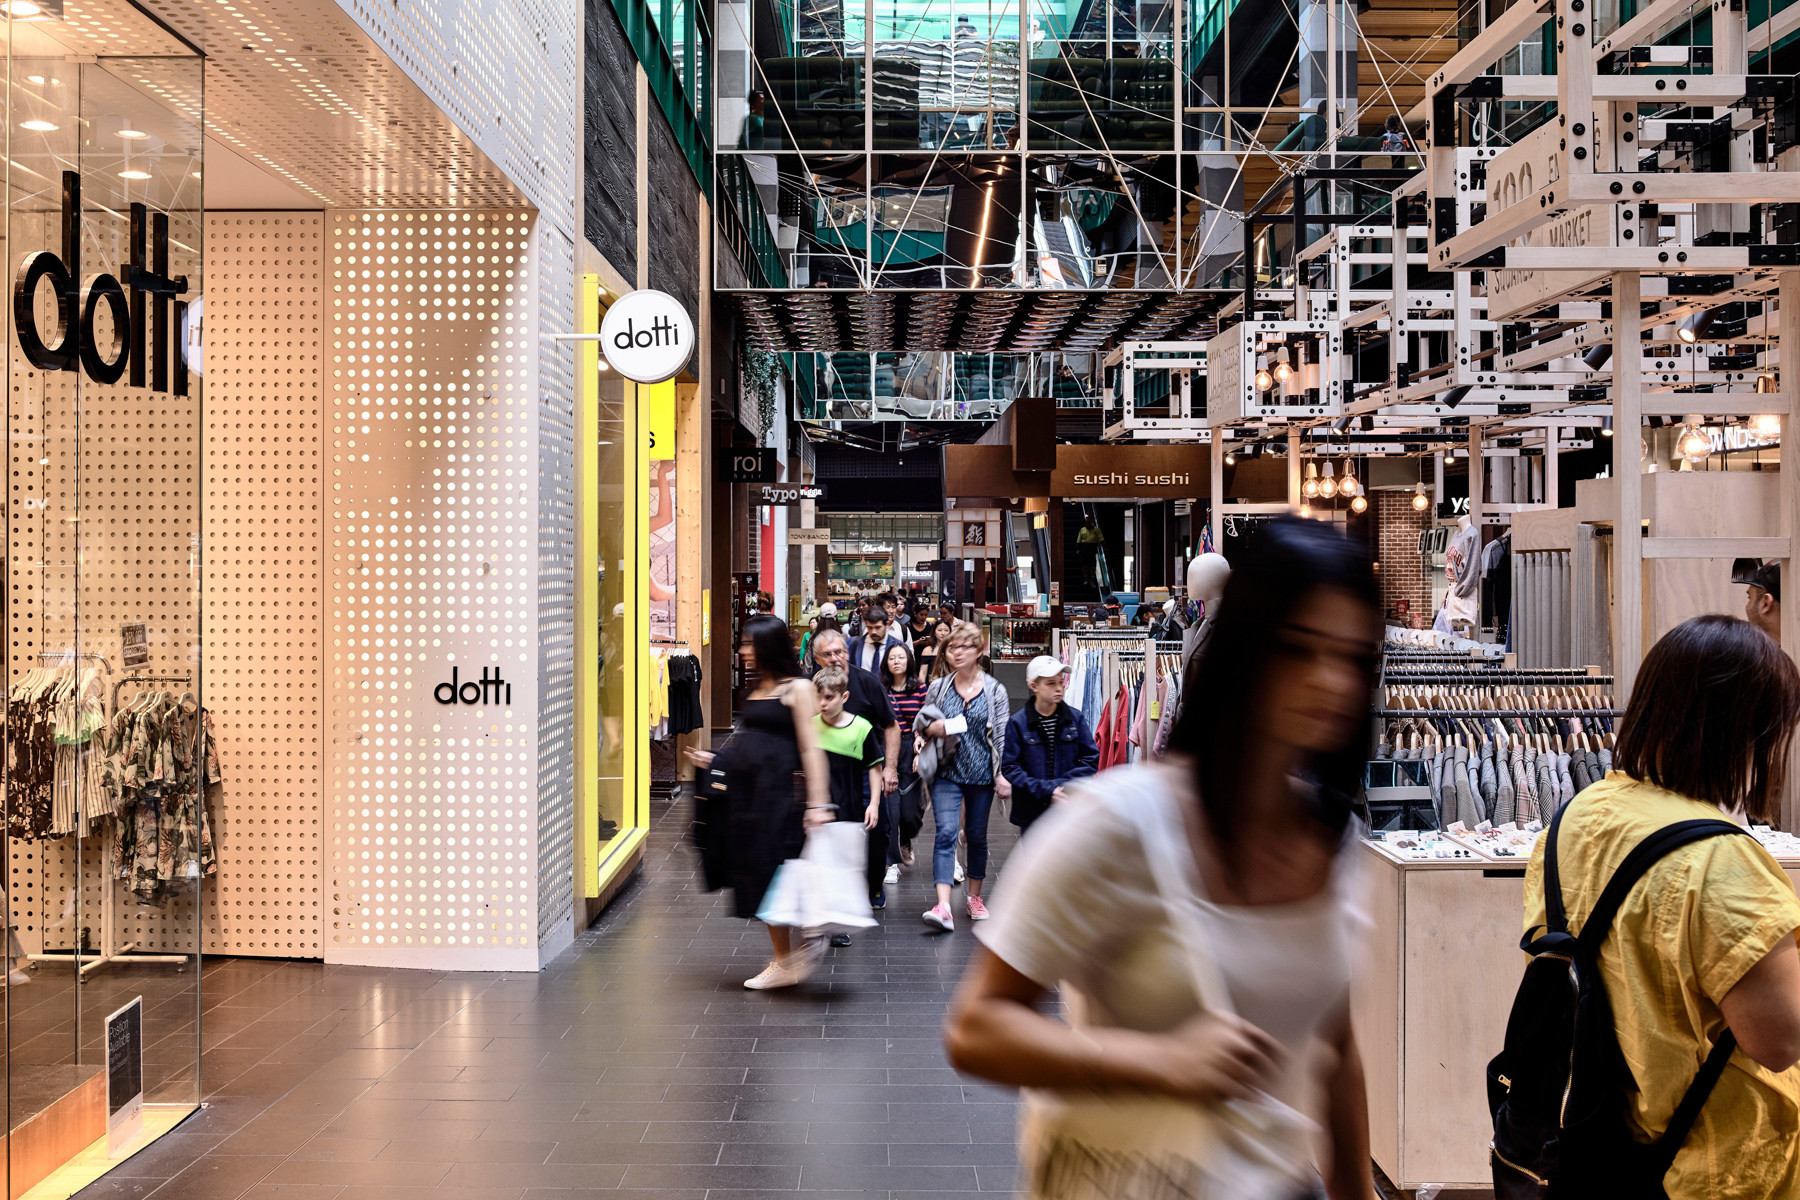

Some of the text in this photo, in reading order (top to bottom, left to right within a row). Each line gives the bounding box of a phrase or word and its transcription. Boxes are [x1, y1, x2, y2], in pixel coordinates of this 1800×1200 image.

[13, 170, 189, 397] dotti
[614, 316, 679, 349] dotti
[733, 451, 762, 472] roi
[1074, 472, 1189, 485] sushi sushi
[762, 486, 798, 503] Typo
[433, 665, 511, 705] dotti
[109, 1019, 129, 1040] Position
[109, 1031, 131, 1053] Available
